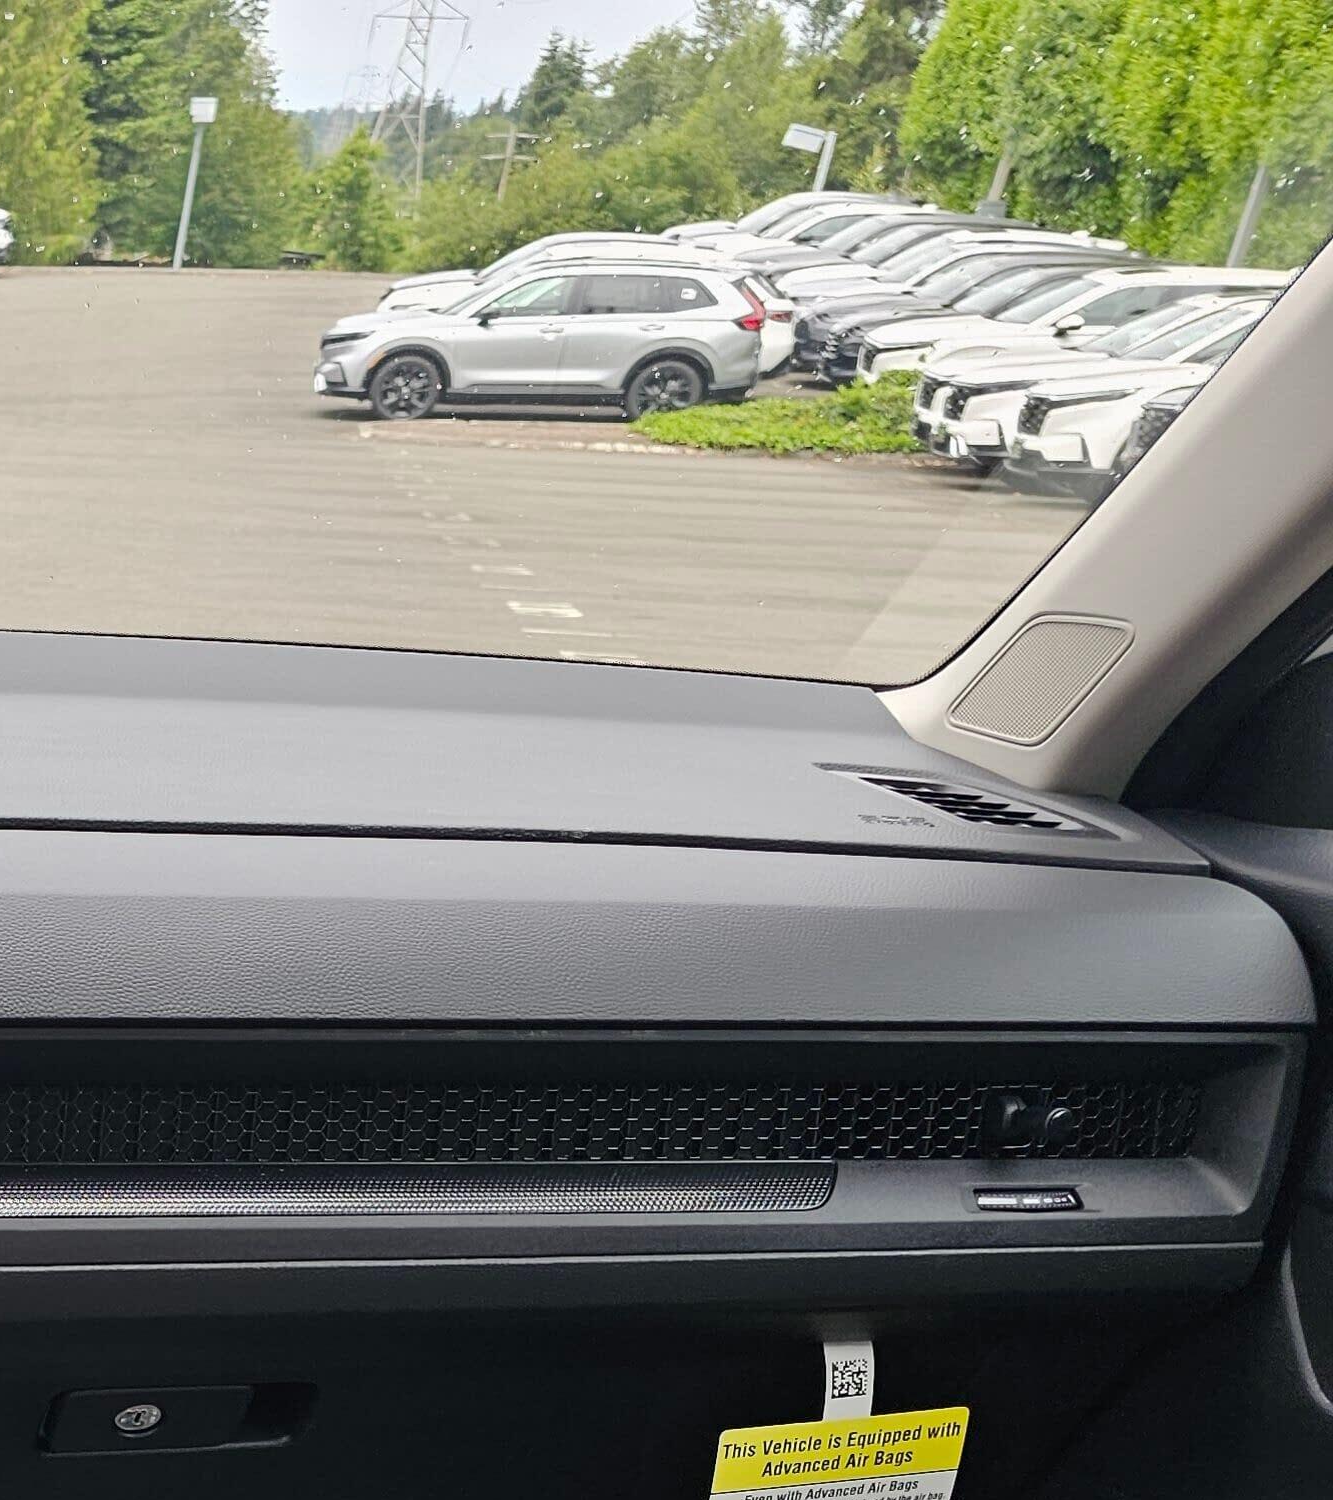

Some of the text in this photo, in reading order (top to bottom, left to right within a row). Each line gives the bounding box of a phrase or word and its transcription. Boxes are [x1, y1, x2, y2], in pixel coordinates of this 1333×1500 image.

[723, 1421, 961, 1459] This Vehicle is Equipped with
[761, 1450, 913, 1477] Advanced Air Bags
[805, 1484, 865, 1500] Advanced
[867, 1482, 886, 1494] Air
[889, 1480, 919, 1492] Bags
[927, 1491, 946, 1500] bag.
